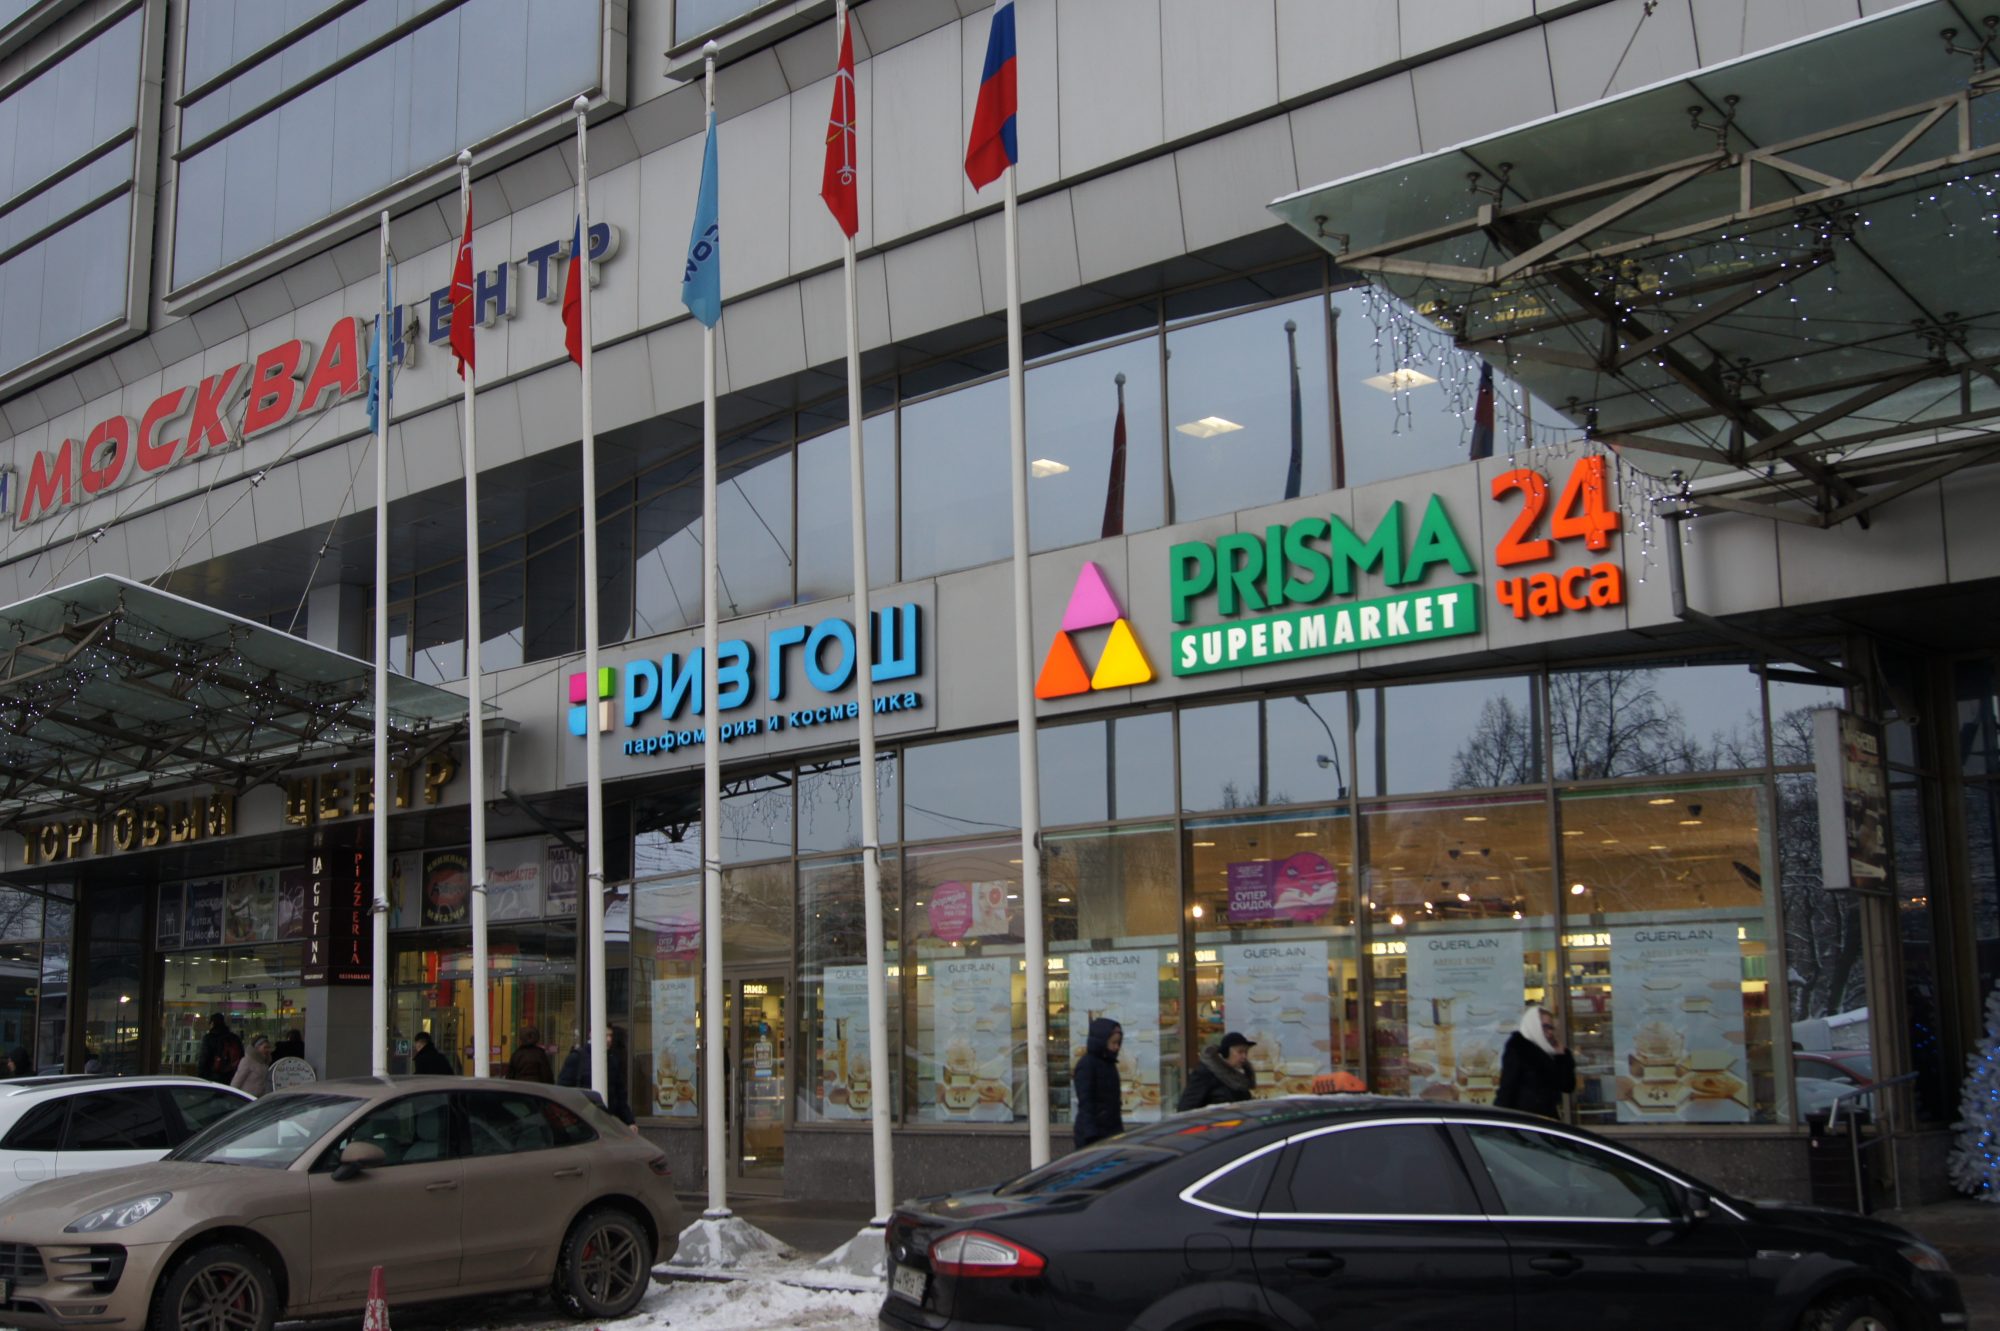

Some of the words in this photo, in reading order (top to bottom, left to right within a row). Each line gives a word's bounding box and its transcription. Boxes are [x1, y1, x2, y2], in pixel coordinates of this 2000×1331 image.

[19, 316, 365, 523] МОСКВА
[1490, 454, 1621, 567] 24
[1169, 493, 1476, 624] PRISMA
[1495, 561, 1623, 620] часа
[1180, 592, 1459, 669] SUPERMARKET
[624, 639, 753, 728] РИВ
[768, 603, 920, 701] ГОШ
[623, 716, 759, 756] парфюмрия
[767, 714, 783, 732] и
[789, 690, 921, 727] космеика
[21, 791, 236, 865] ТОРГОВЫЙ
[553, 864, 577, 884] ОБУ
[1230, 900, 1273, 912] СКИДОК
[1234, 890, 1268, 902] СУПЕР
[1243, 946, 1306, 959] GUERLAIN
[1428, 938, 1499, 951] GUERLAIN
[1634, 929, 1713, 943] GUERLAIN
[948, 963, 995, 974] GUERLAIN
[1086, 955, 1140, 967] GUERLAIN
